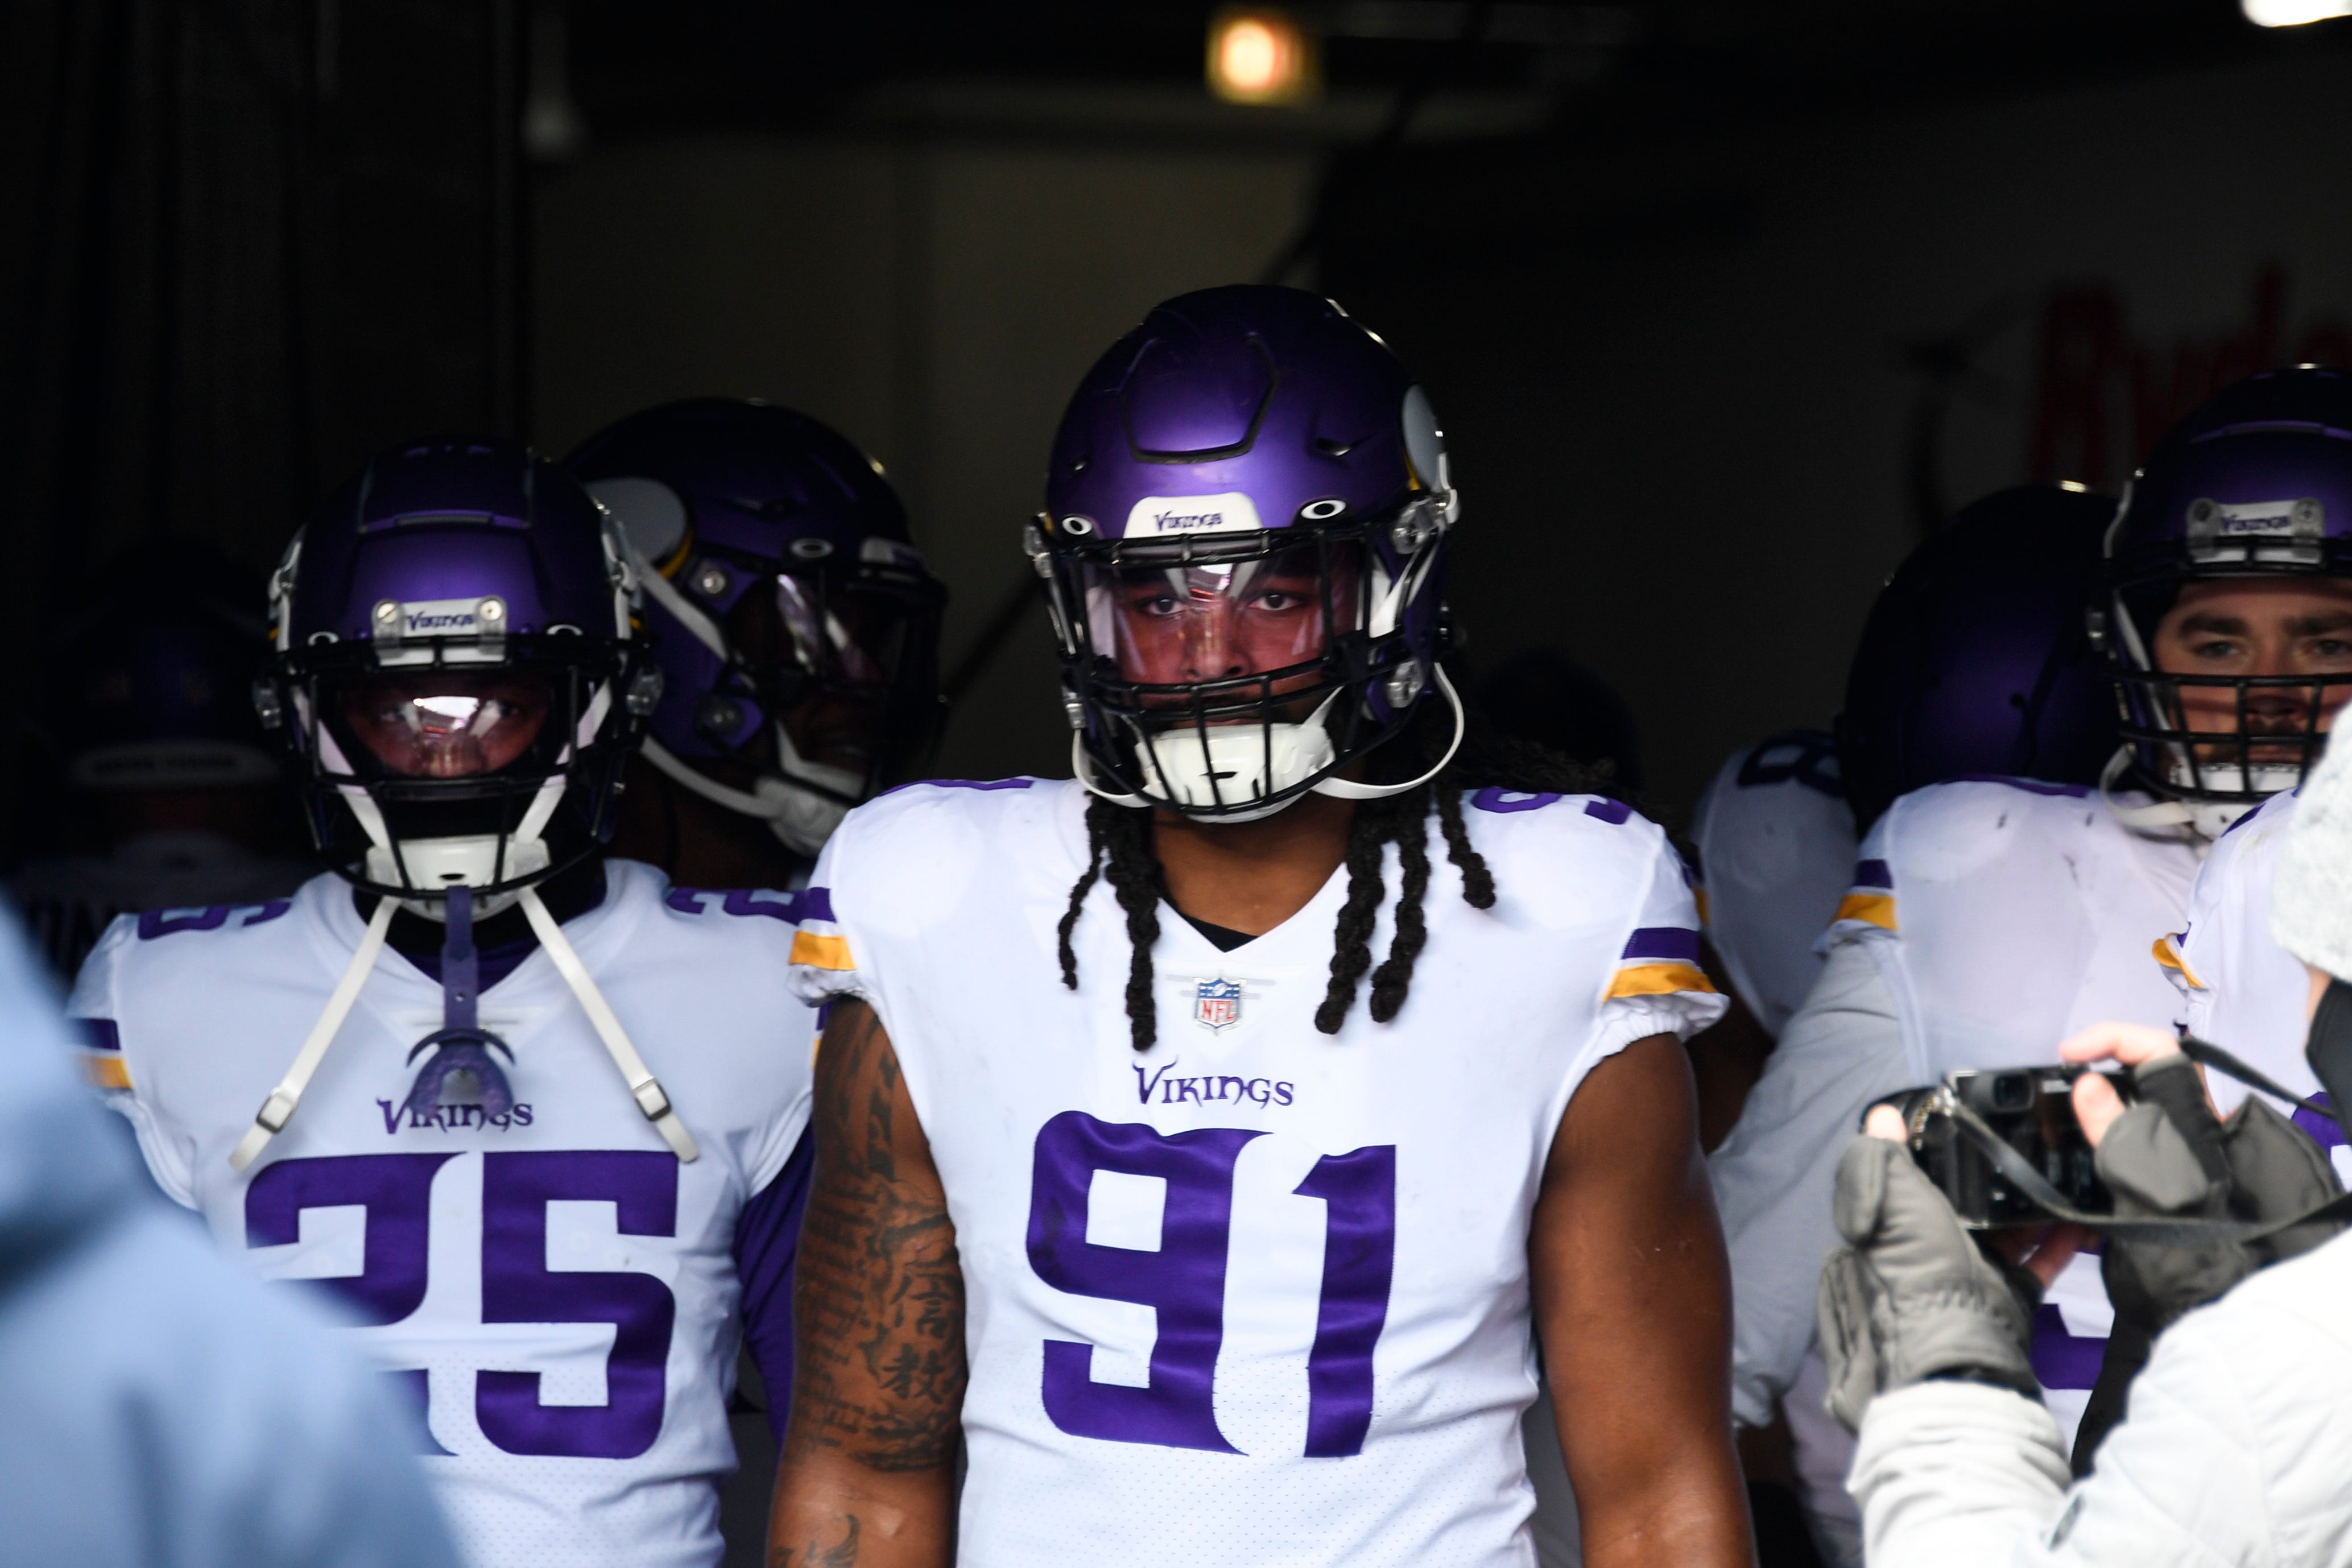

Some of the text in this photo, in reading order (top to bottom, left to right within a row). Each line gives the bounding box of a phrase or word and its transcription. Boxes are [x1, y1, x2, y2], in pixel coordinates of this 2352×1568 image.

[1132, 1054, 1295, 1110] VIKINGS
[1201, 999, 1236, 1023] NFL
[245, 1149, 679, 1459] 25
[1025, 1110, 1396, 1458] 91
